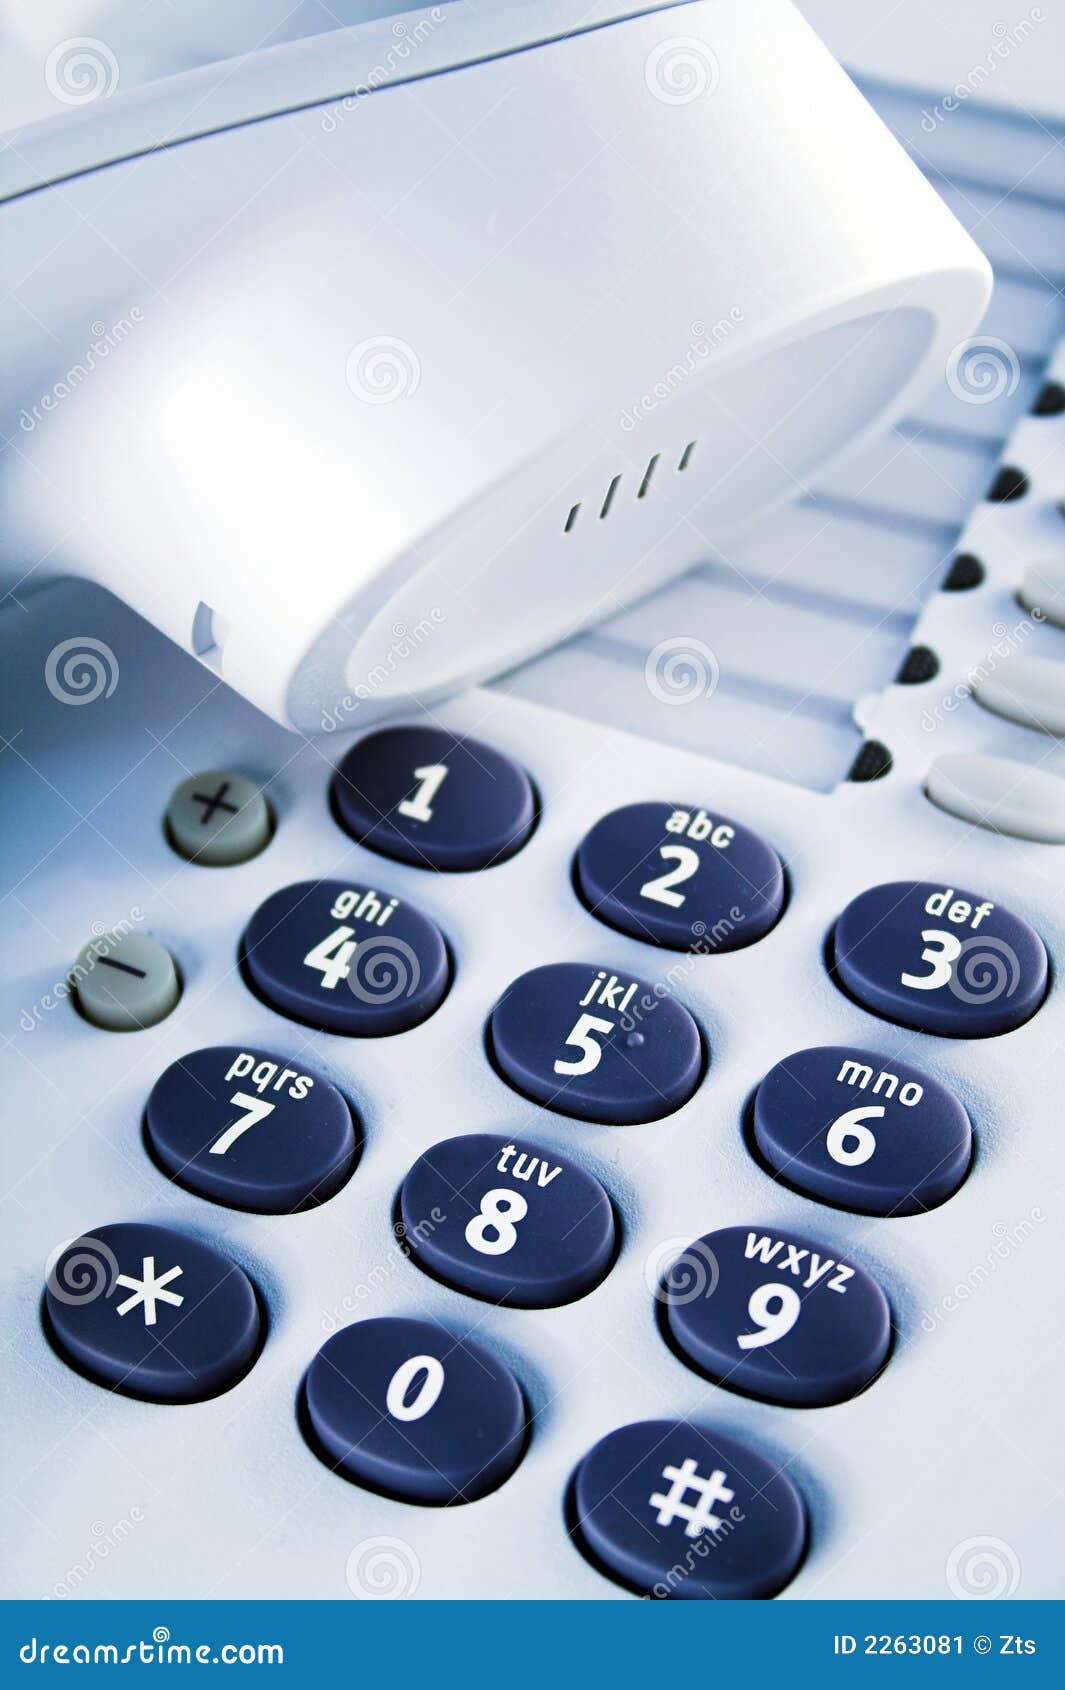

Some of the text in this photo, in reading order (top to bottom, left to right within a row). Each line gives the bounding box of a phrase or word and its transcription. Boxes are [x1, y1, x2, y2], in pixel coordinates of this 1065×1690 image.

[399, 764, 448, 822] 1
[665, 810, 735, 848] abc
[640, 845, 700, 908] 2
[330, 891, 399, 926] ghi
[924, 889, 994, 929] def
[303, 926, 357, 989] 4
[901, 929, 962, 990] 3
[579, 972, 639, 1013] jkl
[553, 1013, 615, 1076] 5
[224, 1053, 314, 1099] pqrs
[836, 1060, 924, 1107] mno
[208, 1092, 276, 1155] 7
[826, 1105, 886, 1167] 6
[496, 1144, 563, 1188] tuv
[464, 1188, 528, 1256] 8
[744, 1232, 856, 1294] wxyz
[737, 1282, 801, 1350] 9
[386, 1355, 445, 1422] 0
[649, 1459, 734, 1538] #
